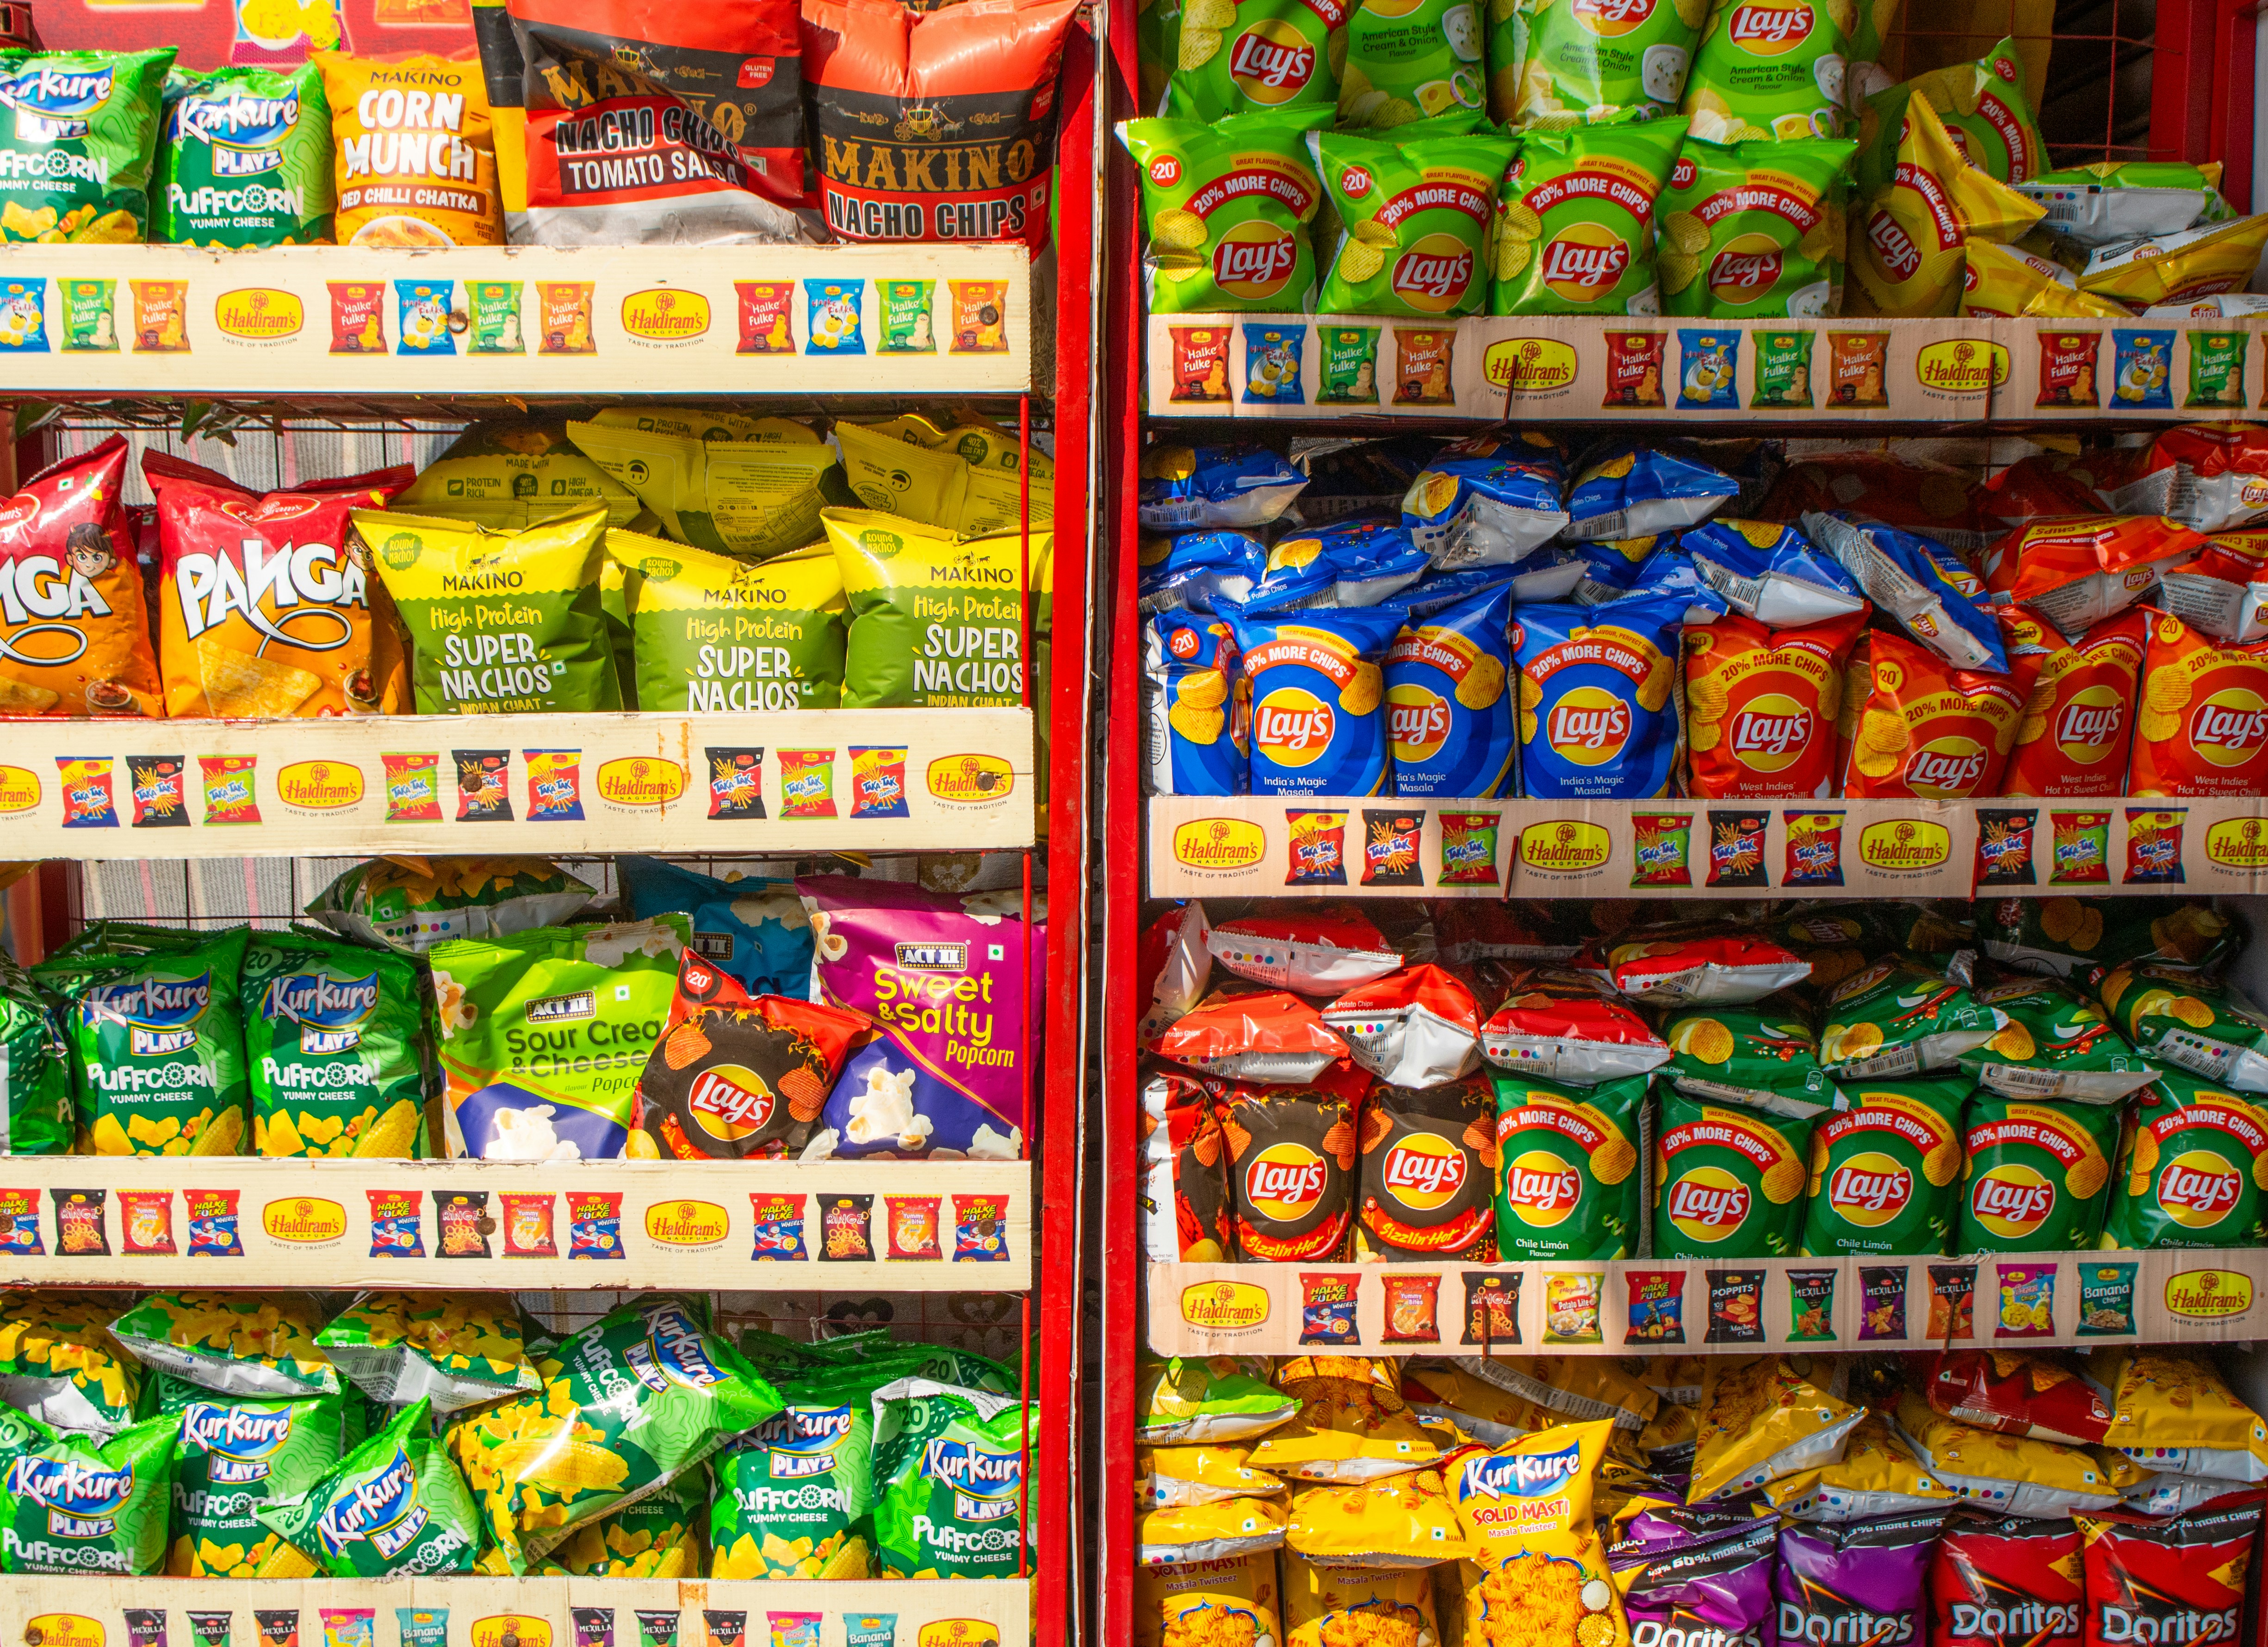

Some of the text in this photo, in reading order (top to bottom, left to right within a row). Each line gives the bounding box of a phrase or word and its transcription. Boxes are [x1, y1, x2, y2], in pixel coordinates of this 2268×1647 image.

[1362, 24, 1436, 43] American Style
[1362, 34, 1438, 53] Cream & Onion
[1234, 34, 1315, 87] Lay's
[1389, 48, 1417, 58] Flavour
[370, 71, 462, 87] MAKINO
[177, 92, 298, 144] Kurkure
[358, 89, 466, 131] CORN
[556, 106, 655, 156] NACHO
[216, 149, 280, 175] PLAYZ
[343, 133, 477, 180] MUNCH
[823, 134, 1035, 192] MAKINO
[1236, 157, 1254, 167] GREAT
[568, 150, 740, 191] TOMATO SALSA
[34, 180, 76, 193] CHEESE
[1193, 175, 1304, 214] 20% MORE CHIPS
[342, 187, 478, 211] RED CHILLI CHATKA
[190, 217, 275, 229] YUMMY CHEESE
[827, 188, 1026, 240] NACHO CHIPS
[474, 221, 495, 232] GLUTEN
[477, 230, 492, 241] FREE
[1547, 242, 1625, 286] Lay's
[74, 299, 102, 312] Halke
[71, 310, 96, 323] Fulke
[224, 307, 296, 328] Haldiram's
[630, 309, 702, 330] Haldiram's
[222, 336, 245, 348] TASTE
[259, 337, 297, 348] TRADITION
[1188, 345, 1216, 359] Halke
[1184, 358, 1210, 372] Fulke
[466, 477, 501, 488] PROTEIN
[466, 488, 485, 498] RICH
[442, 571, 523, 591] MAKINO
[930, 567, 1014, 583] MAKINO
[177, 539, 369, 642] PANGA
[1251, 583, 1288, 601] Potato Chips
[430, 602, 542, 634] High Protein
[913, 595, 960, 624] High
[445, 633, 538, 667] SUPER
[923, 624, 1019, 659] SUPER
[1269, 646, 1307, 662] MORE
[1310, 649, 1347, 678] CHIPS
[1720, 652, 1828, 682] 20% MORE CHIPS
[440, 664, 552, 701] NACHOS
[913, 660, 1022, 694] NACHOS
[503, 698, 541, 712] CHAAT
[1258, 707, 1329, 750] Lay's
[1553, 705, 1625, 749] Lay's
[1735, 712, 1808, 755] Lay's
[2061, 705, 2121, 746] Lay's
[286, 779, 357, 799] Haldiram's
[1264, 777, 1327, 787] India's Magic
[1277, 788, 1314, 796] Masala
[1740, 781, 1761, 791] West
[226, 790, 249, 804] Gathiya
[1182, 838, 1258, 859] Haldiram's
[1315, 851, 1338, 864] Gathiya
[1528, 840, 1603, 861] Haldiram's
[1179, 867, 1203, 877] TASTE
[1219, 867, 1259, 879] TRADITION
[904, 948, 936, 964] ACT
[874, 968, 993, 1003] Sweet
[89, 976, 210, 1029] Kurkure
[532, 996, 589, 1017] ACT II
[133, 1028, 195, 1054] PLAYZ
[505, 1019, 667, 1054] Sour Crea
[945, 1040, 1015, 1070] Popcorn
[564, 1076, 640, 1094] Flavour Popco
[110, 1091, 194, 1104] YUMMY CHEESE
[692, 1072, 774, 1122] Lay's
[1498, 1111, 1595, 1144] 20% MORE CHIPS
[1388, 1149, 1462, 1194] Lay's
[1510, 1168, 1577, 1211] Lay's
[1834, 1169, 1908, 1211] Lay's
[2162, 1166, 2238, 1212] Lay's
[61, 1207, 99, 1220] RINGZ
[377, 1201, 411, 1212] HALKE
[377, 1209, 410, 1218] FULKE
[270, 1214, 339, 1233] Haldiram's
[398, 1216, 421, 1224] WHEELS
[1428, 1228, 1456, 1245] Hot
[1516, 1238, 1569, 1250] Chile Limón
[1529, 1250, 1555, 1259] Flavour
[1712, 1284, 1754, 1298] POPPITS
[1794, 1286, 1832, 1297] MEXILLA
[2084, 1284, 2130, 1299] Banana
[2101, 1296, 2121, 1304] Chips
[1188, 1301, 1262, 1319] Haldiram's
[1558, 1299, 1590, 1311] Potato Lite
[15, 1455, 132, 1508] Kurkure
[1463, 1453, 1580, 1502] Kurkure
[1472, 1498, 1570, 1526] SOLID MASTI
[51, 1511, 113, 1536] PLAYZ
[1488, 1521, 1557, 1538] Masala Twisteez
[935, 1550, 1012, 1562] YUMMY CHEESE
[1711, 1542, 1744, 1560] MORE
[1746, 1532, 1776, 1548] CHIPS
[131, 1623, 166, 1635] MEXILLA
[1778, 1601, 1913, 1643] Doritos
[2101, 1605, 2237, 1646] Doritos
[848, 1630, 892, 1644] Banana
